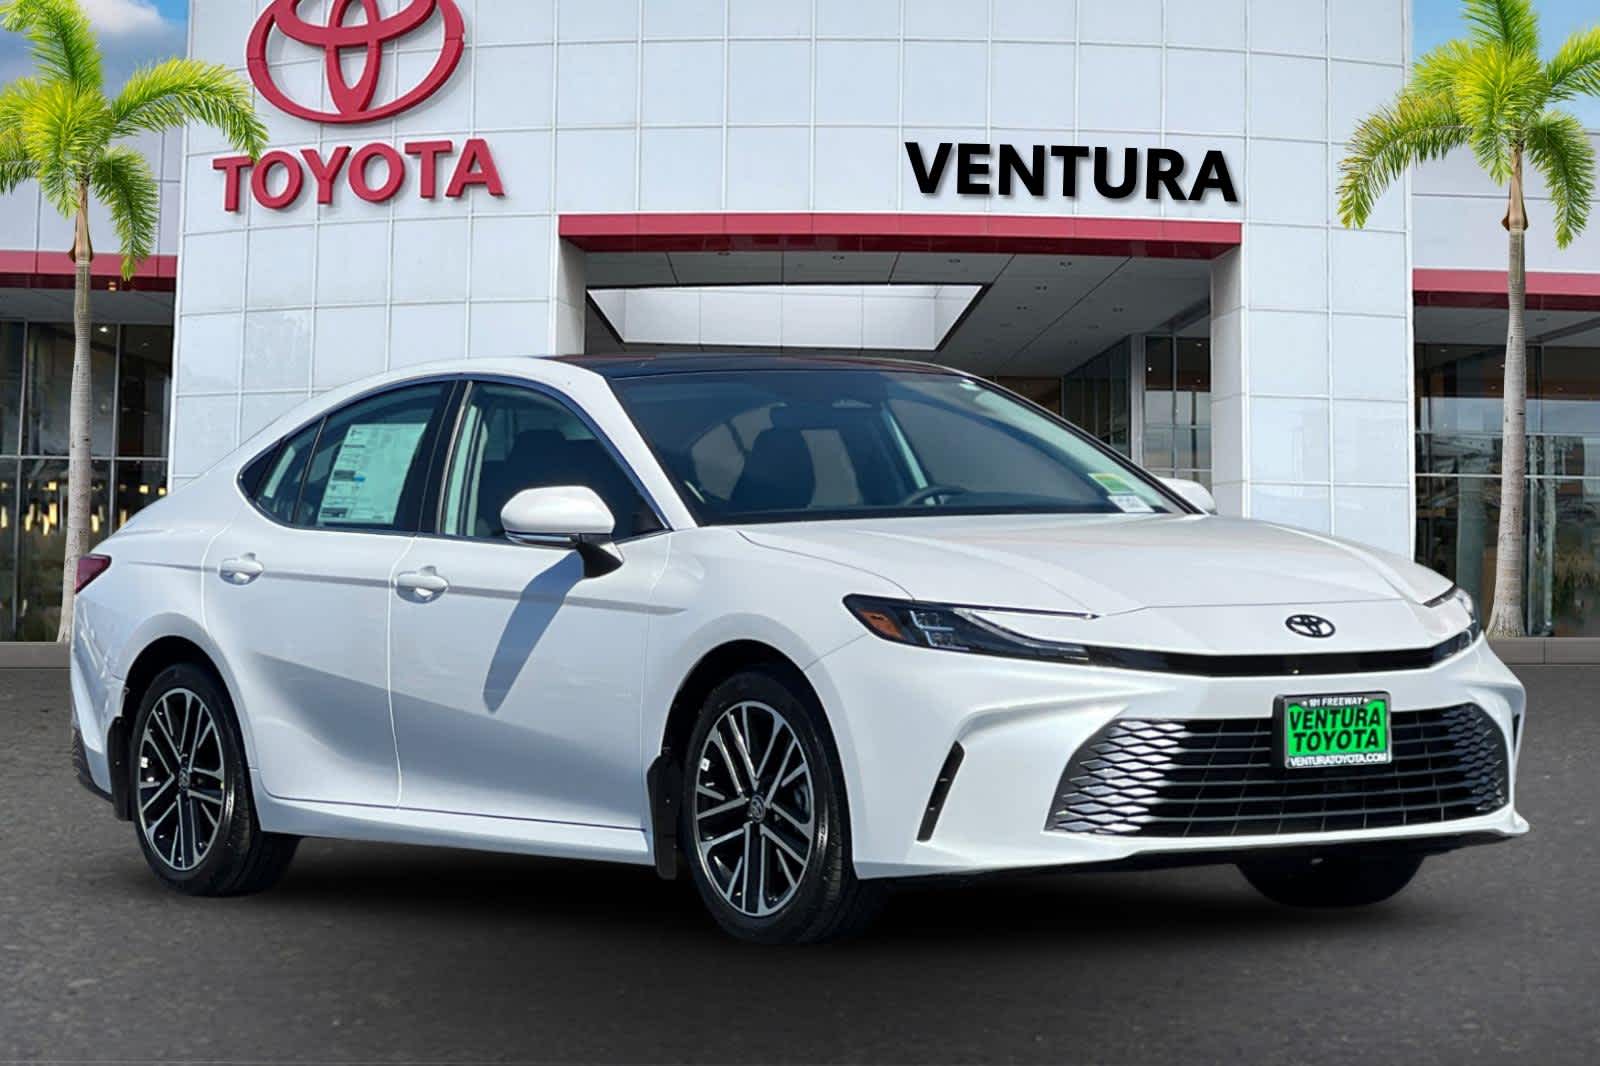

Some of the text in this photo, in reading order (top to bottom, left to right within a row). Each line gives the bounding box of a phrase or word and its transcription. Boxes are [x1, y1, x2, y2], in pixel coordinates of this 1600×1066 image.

[213, 138, 504, 212] TOYOTA
[904, 141, 1238, 203] VENTURA
[1322, 697, 1362, 706] FREEWAY
[1289, 707, 1380, 730] VENTURA
[1294, 728, 1379, 752] TOYOTA
[1289, 753, 1387, 767] VENTURATOYOTA.COM
